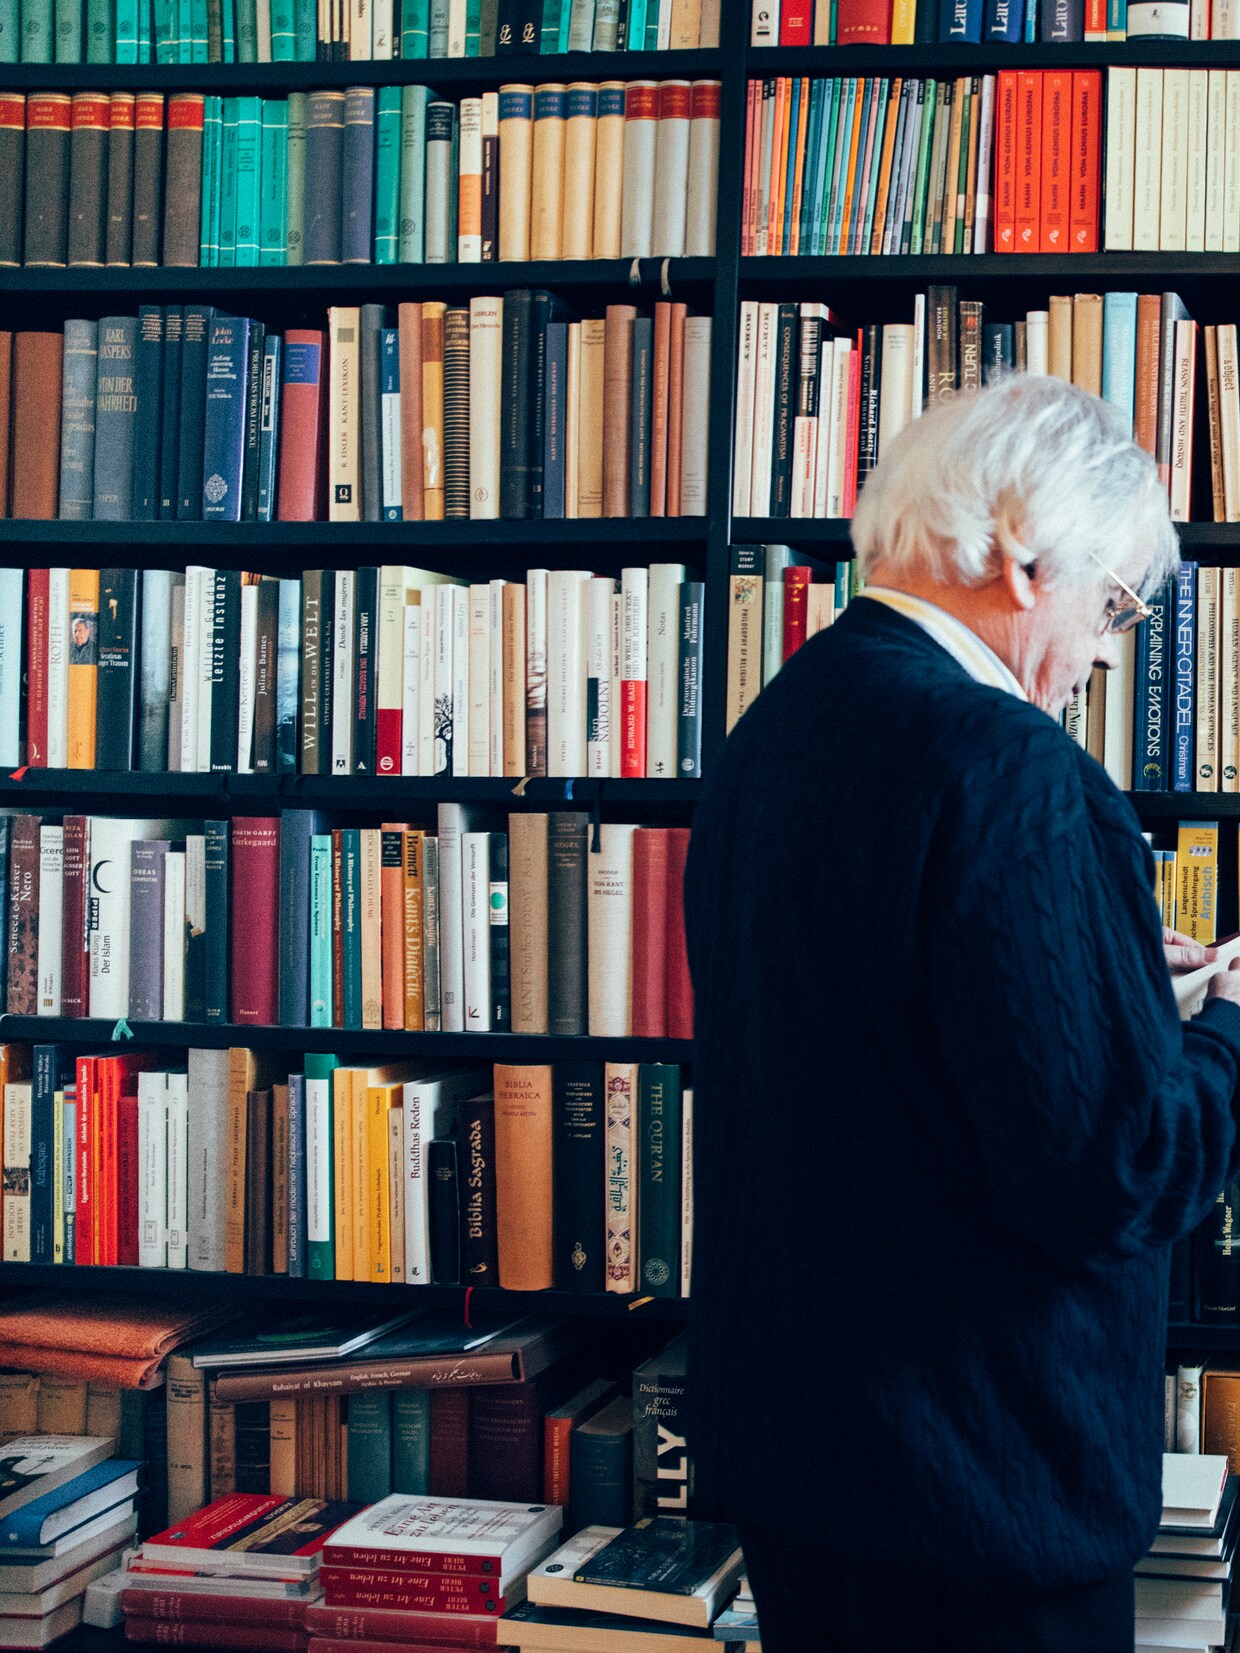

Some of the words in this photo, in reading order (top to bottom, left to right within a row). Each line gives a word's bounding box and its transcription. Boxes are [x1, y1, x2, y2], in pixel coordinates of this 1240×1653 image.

[781, 327, 790, 390] CONSEQUENCES
[781, 394, 788, 404] OF
[868, 390, 877, 424] Richard
[779, 408, 787, 460] PRAGMATISM
[866, 428, 875, 452] Rorty
[214, 577, 225, 629] Instanz
[1179, 568, 1192, 598] THE
[306, 597, 317, 658] WELT
[1149, 605, 1163, 680] EXPLAINING
[1178, 601, 1192, 655] INNER
[213, 639, 224, 682] Letzte
[258, 668, 266, 695] Julian
[311, 679, 316, 689] IN
[1177, 657, 1192, 733] CITADEL
[304, 692, 316, 750] WILL
[1147, 686, 1162, 757] EMOTIONS
[1178, 735, 1188, 778] Christman
[407, 835, 418, 877] Bennett
[11, 864, 20, 901] Kaiser
[20, 872, 32, 901] Nero
[1200, 866, 1212, 920] Arabisch
[101, 935, 111, 957] Islam
[102, 960, 110, 973] Der
[289, 1087, 297, 1119] Sprache
[411, 1097, 420, 1129] Reden
[651, 1083, 663, 1115] THE
[411, 1133, 420, 1178] Buddhas
[469, 1120, 485, 1187] Sagrada
[468, 1193, 482, 1238] Biblia
[639, 1384, 684, 1395] Dictionnaire
[642, 1406, 678, 1418] français
[657, 1422, 688, 1521] LLY
